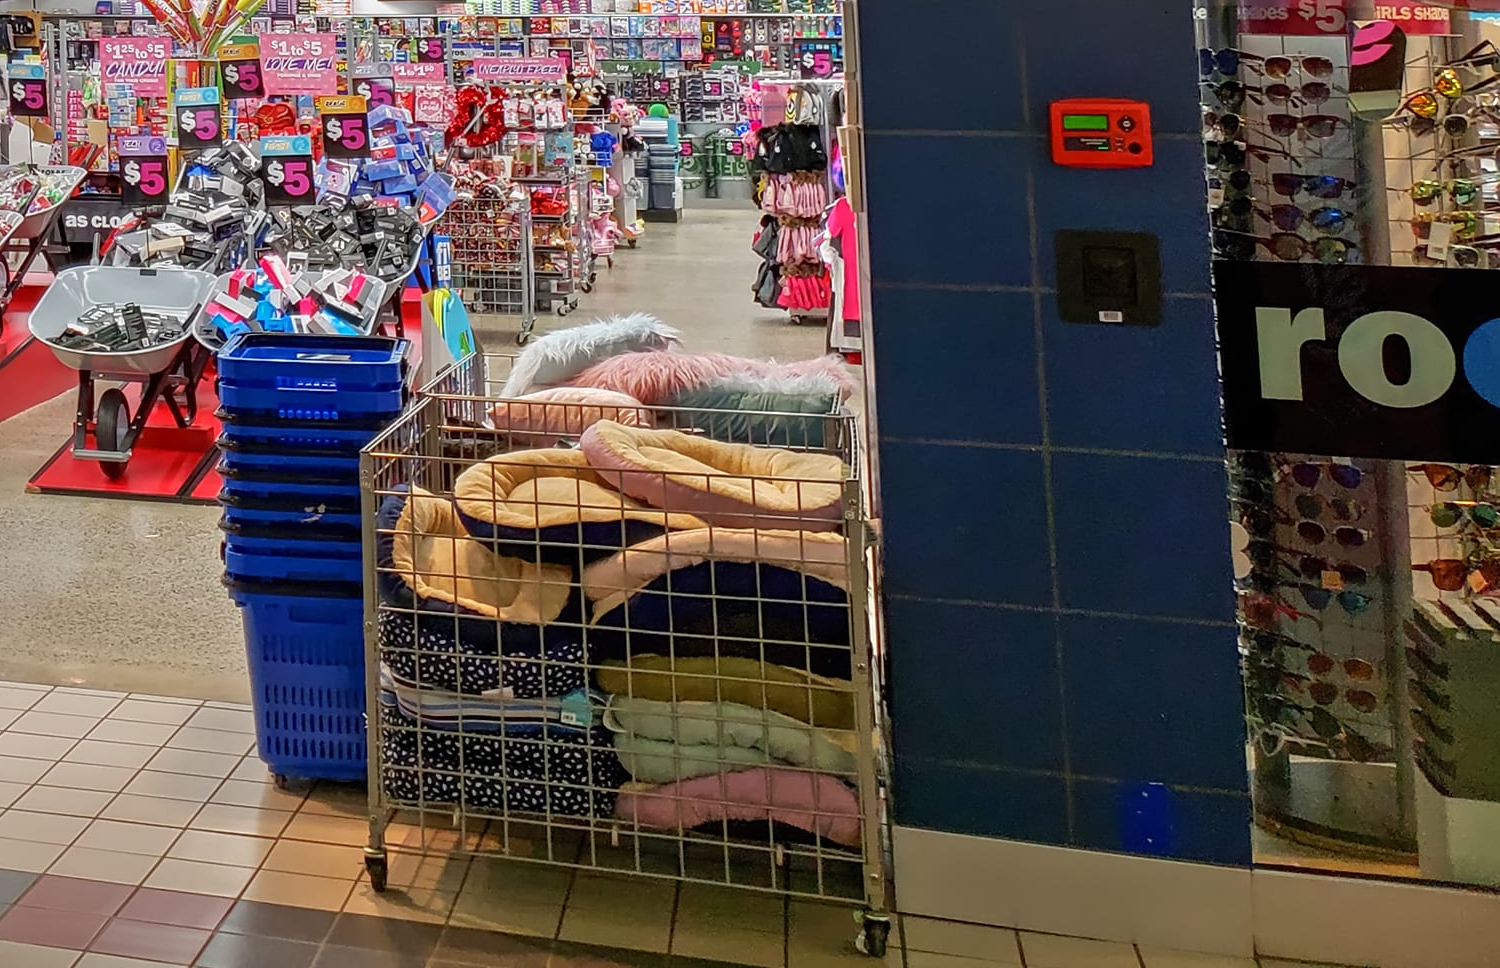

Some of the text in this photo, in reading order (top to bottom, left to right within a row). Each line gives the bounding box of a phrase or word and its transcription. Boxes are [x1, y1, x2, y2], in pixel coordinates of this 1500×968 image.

[135, 48, 147, 59] to
[147, 43, 165, 59] $5
[270, 39, 323, 56] $1 to $5
[418, 38, 443, 59] $5
[105, 59, 168, 79] CANDY!
[264, 57, 300, 72] LOVE
[301, 55, 334, 72] ME!
[802, 51, 832, 75] $5
[225, 64, 260, 92] $5
[654, 80, 670, 94] $5
[704, 82, 721, 95] $5
[12, 81, 44, 110] $5
[357, 82, 393, 108] $5
[181, 109, 218, 142] $5
[326, 118, 366, 150] $5
[726, 141, 743, 155] $5
[124, 160, 166, 196] $5
[267, 160, 310, 197] $5
